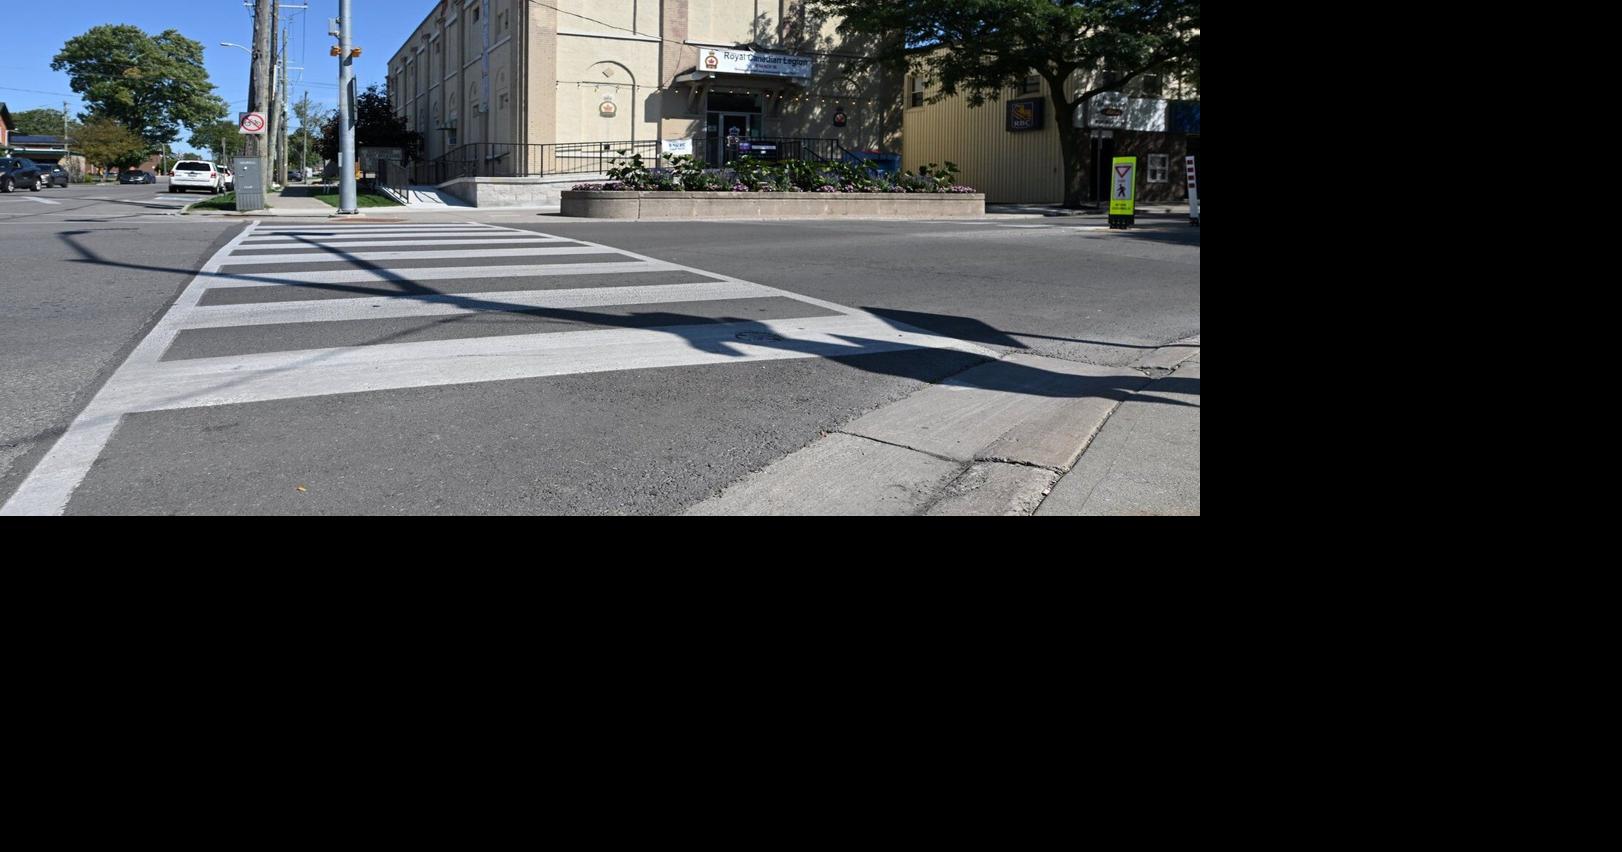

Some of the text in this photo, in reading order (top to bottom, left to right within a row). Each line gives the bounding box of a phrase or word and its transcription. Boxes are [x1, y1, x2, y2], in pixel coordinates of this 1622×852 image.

[724, 52, 746, 61] Royal
[747, 54, 782, 64] Canadian
[783, 57, 808, 67] Legion
[1014, 120, 1031, 128] RBC
